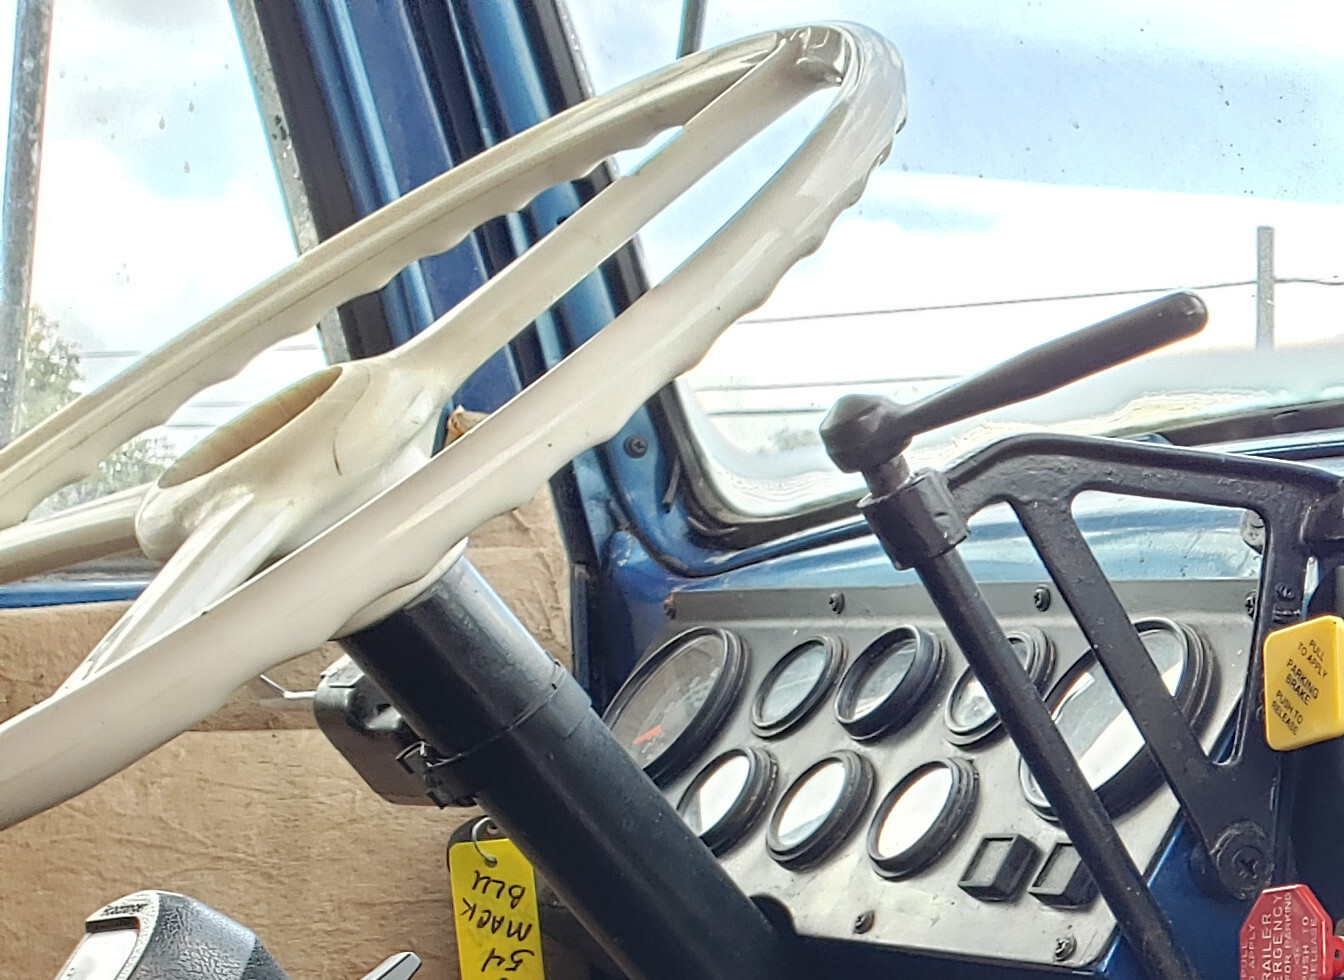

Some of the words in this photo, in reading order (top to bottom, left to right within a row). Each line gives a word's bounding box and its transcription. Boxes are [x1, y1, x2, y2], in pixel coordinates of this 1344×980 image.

[1298, 641, 1308, 656] TO
[1306, 653, 1328, 678] APPLY
[1308, 639, 1325, 662] PULL
[1285, 673, 1312, 706] BRAKE
[1286, 658, 1319, 700] PARKING
[1270, 700, 1299, 736] RELEASE
[1275, 690, 1293, 714] PUSH
[1293, 709, 1304, 725] TO
[471, 869, 527, 910] BLU
[460, 897, 533, 942] MACK
[1284, 892, 1292, 949] PARKING
[1302, 916, 1309, 933] TO
[1248, 924, 1256, 969] APPLY
